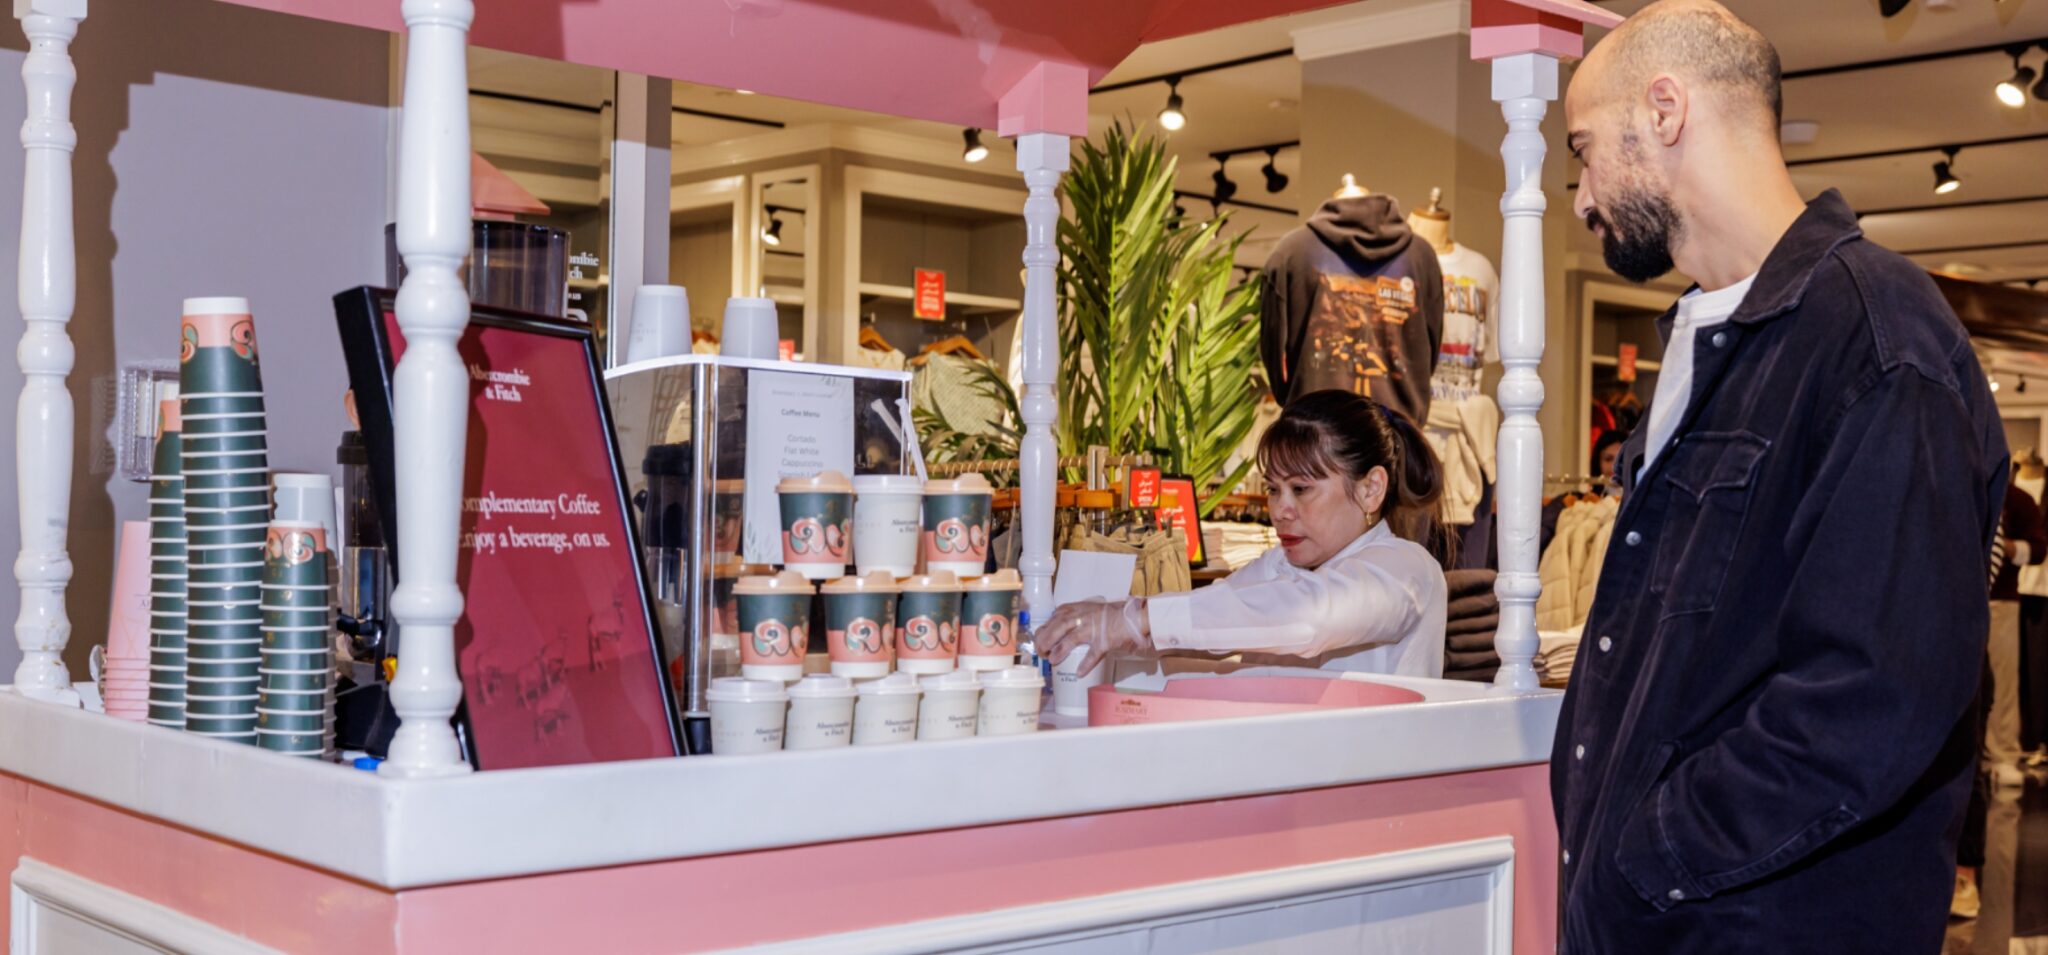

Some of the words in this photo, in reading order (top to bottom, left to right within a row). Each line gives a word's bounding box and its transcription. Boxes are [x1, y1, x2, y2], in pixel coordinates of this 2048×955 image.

[469, 363, 531, 386] Abercrombie
[494, 384, 522, 402] Fitch
[781, 408, 802, 417] Coffee
[803, 410, 820, 418] Menu
[787, 434, 816, 444] Cortado
[461, 491, 556, 520] omplementary
[558, 493, 601, 515] Coffee
[499, 532, 509, 547] a
[508, 525, 573, 554] beverage,
[573, 532, 591, 547] on
[593, 532, 610, 547] us.
